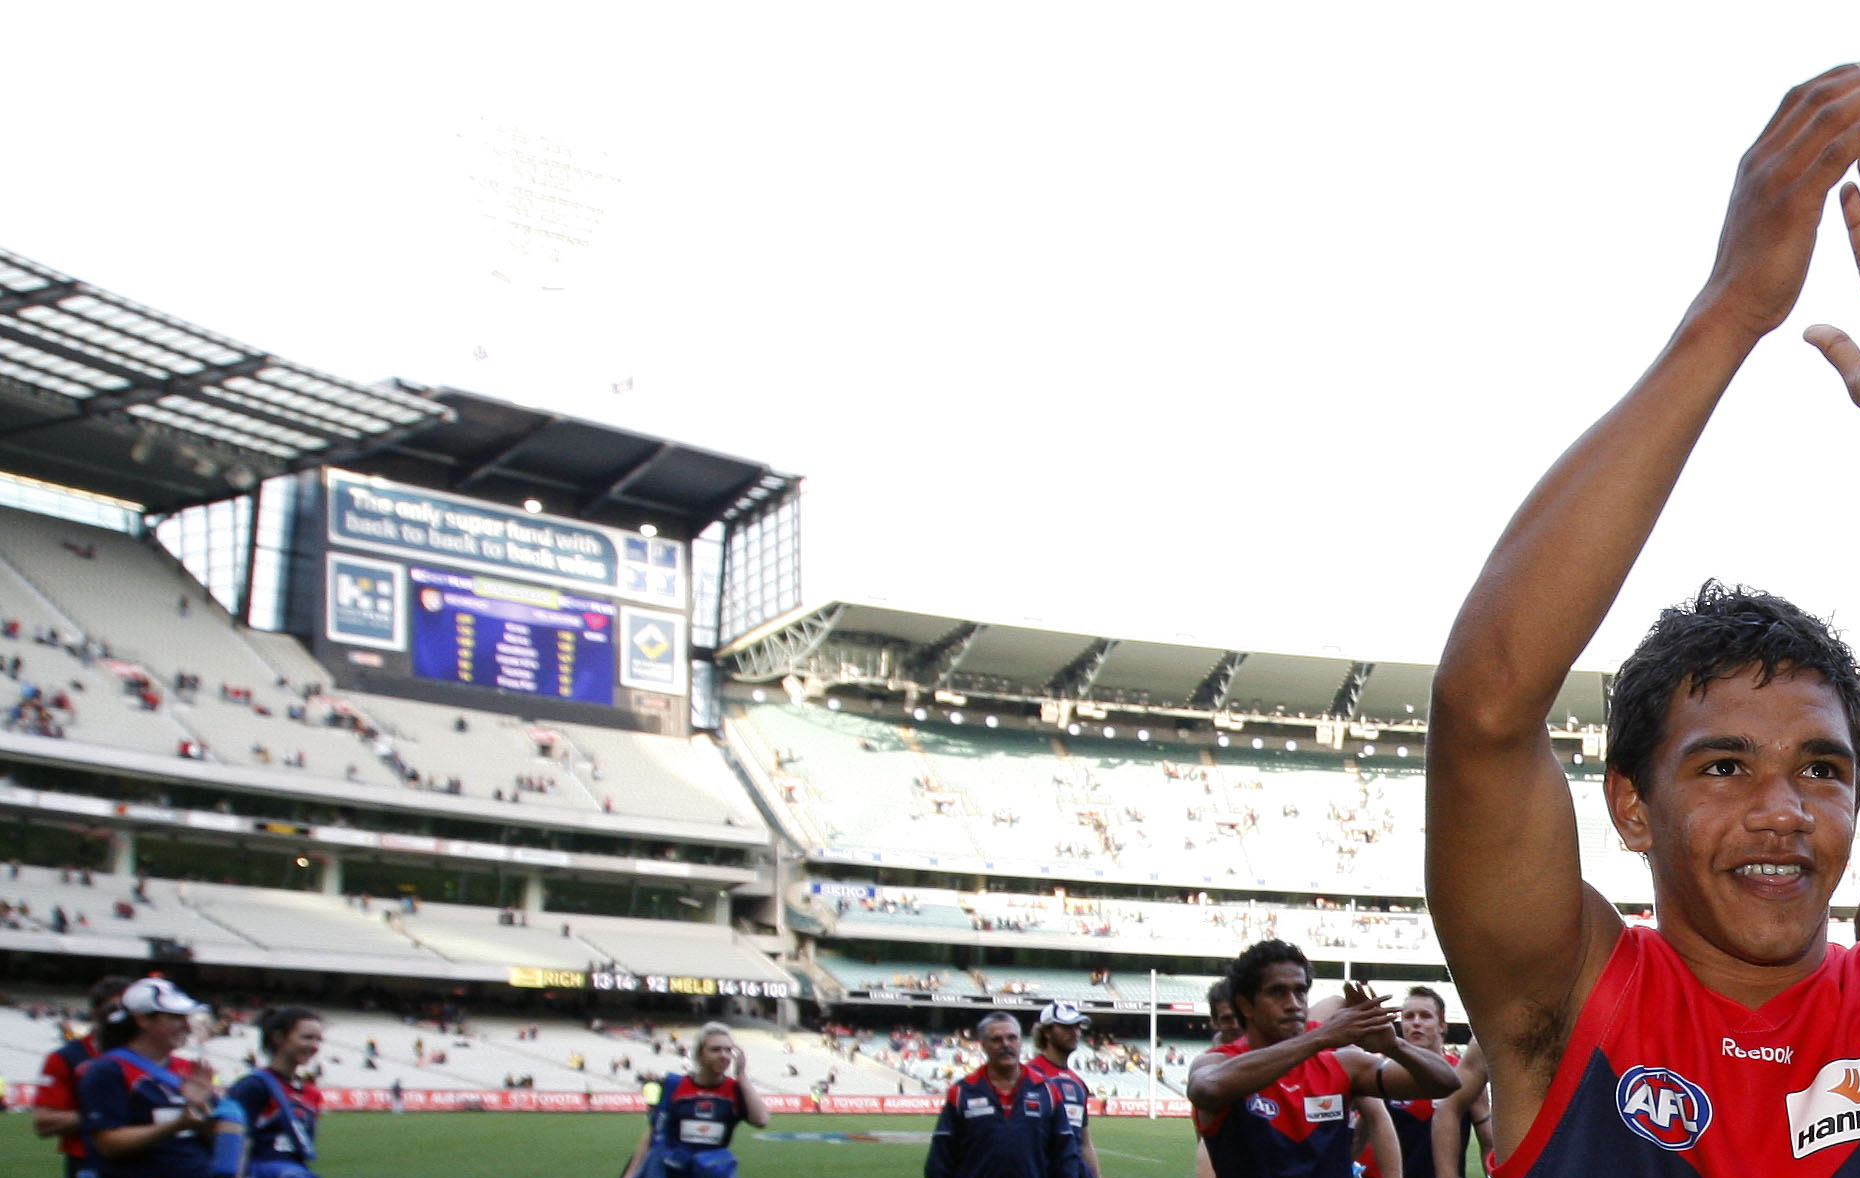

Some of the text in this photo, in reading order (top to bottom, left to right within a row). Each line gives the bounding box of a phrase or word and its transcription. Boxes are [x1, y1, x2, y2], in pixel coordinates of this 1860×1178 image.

[822, 883, 866, 898] SEIKO
[543, 970, 582, 988] RICH
[647, 976, 668, 992] 92
[670, 976, 716, 995] MELB
[1722, 1037, 1795, 1065] Reebok
[833, 1097, 879, 1109] TOYOTA
[884, 1098, 929, 1109] AURION
[1623, 1080, 1699, 1133] AFL
